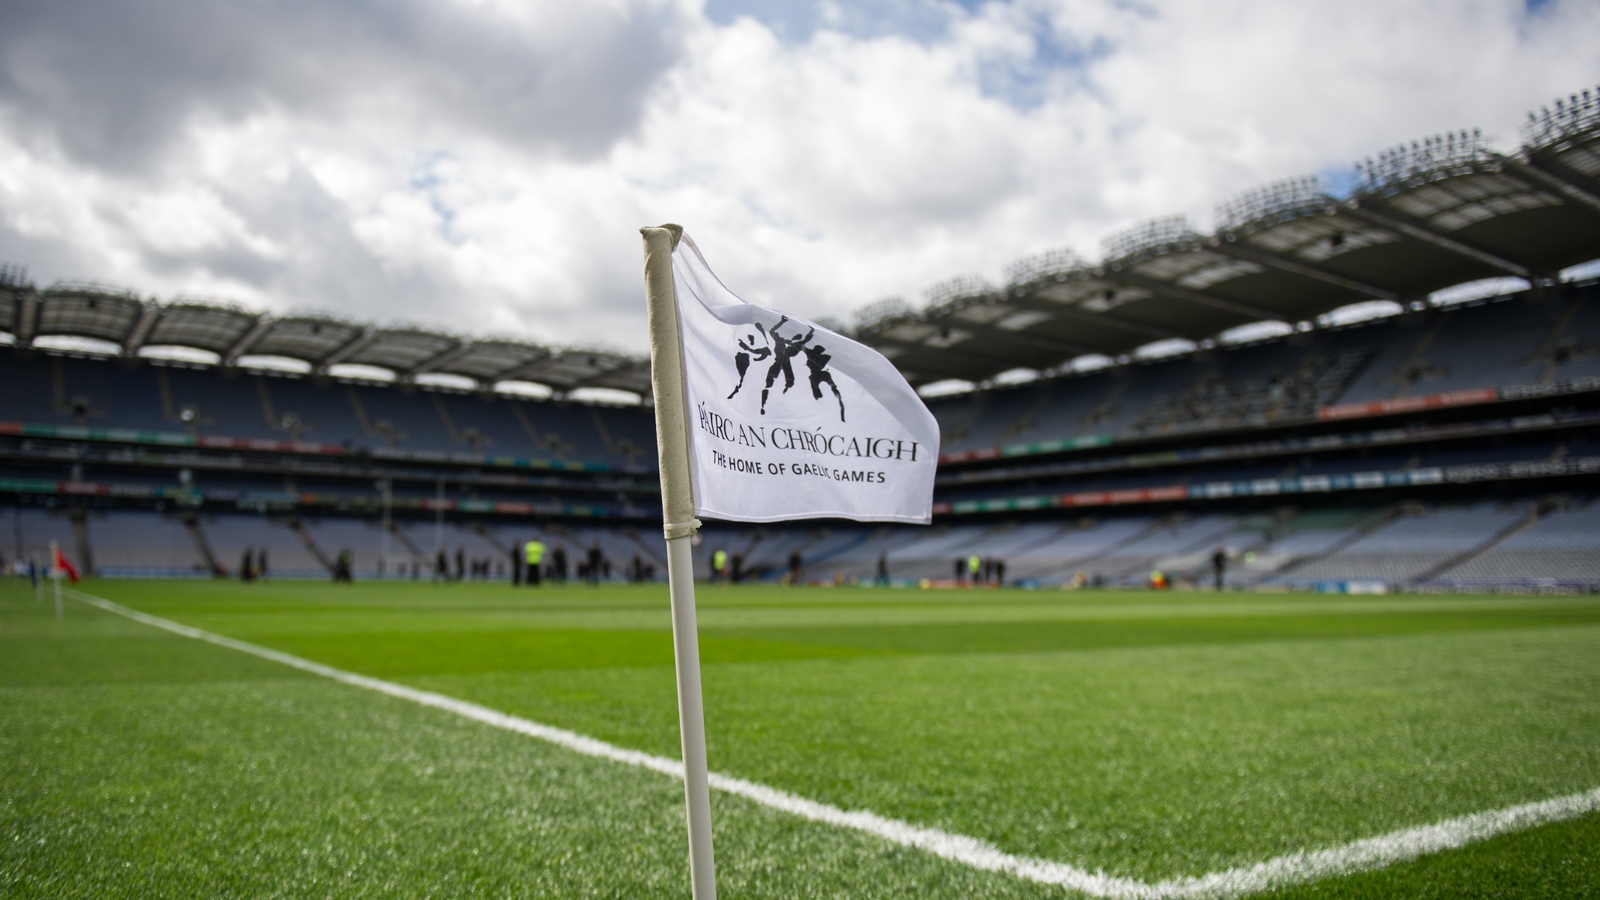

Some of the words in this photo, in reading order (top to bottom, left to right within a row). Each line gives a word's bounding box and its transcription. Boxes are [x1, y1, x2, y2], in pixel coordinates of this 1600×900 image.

[697, 400, 735, 443] PÁIRC
[739, 423, 766, 448] AN
[771, 426, 919, 462] CHRÓCAIGH
[712, 449, 727, 468] THE
[728, 456, 763, 474] HOME
[767, 462, 786, 475] OF
[791, 463, 831, 479] GAELIC
[833, 469, 886, 483] GAMES
